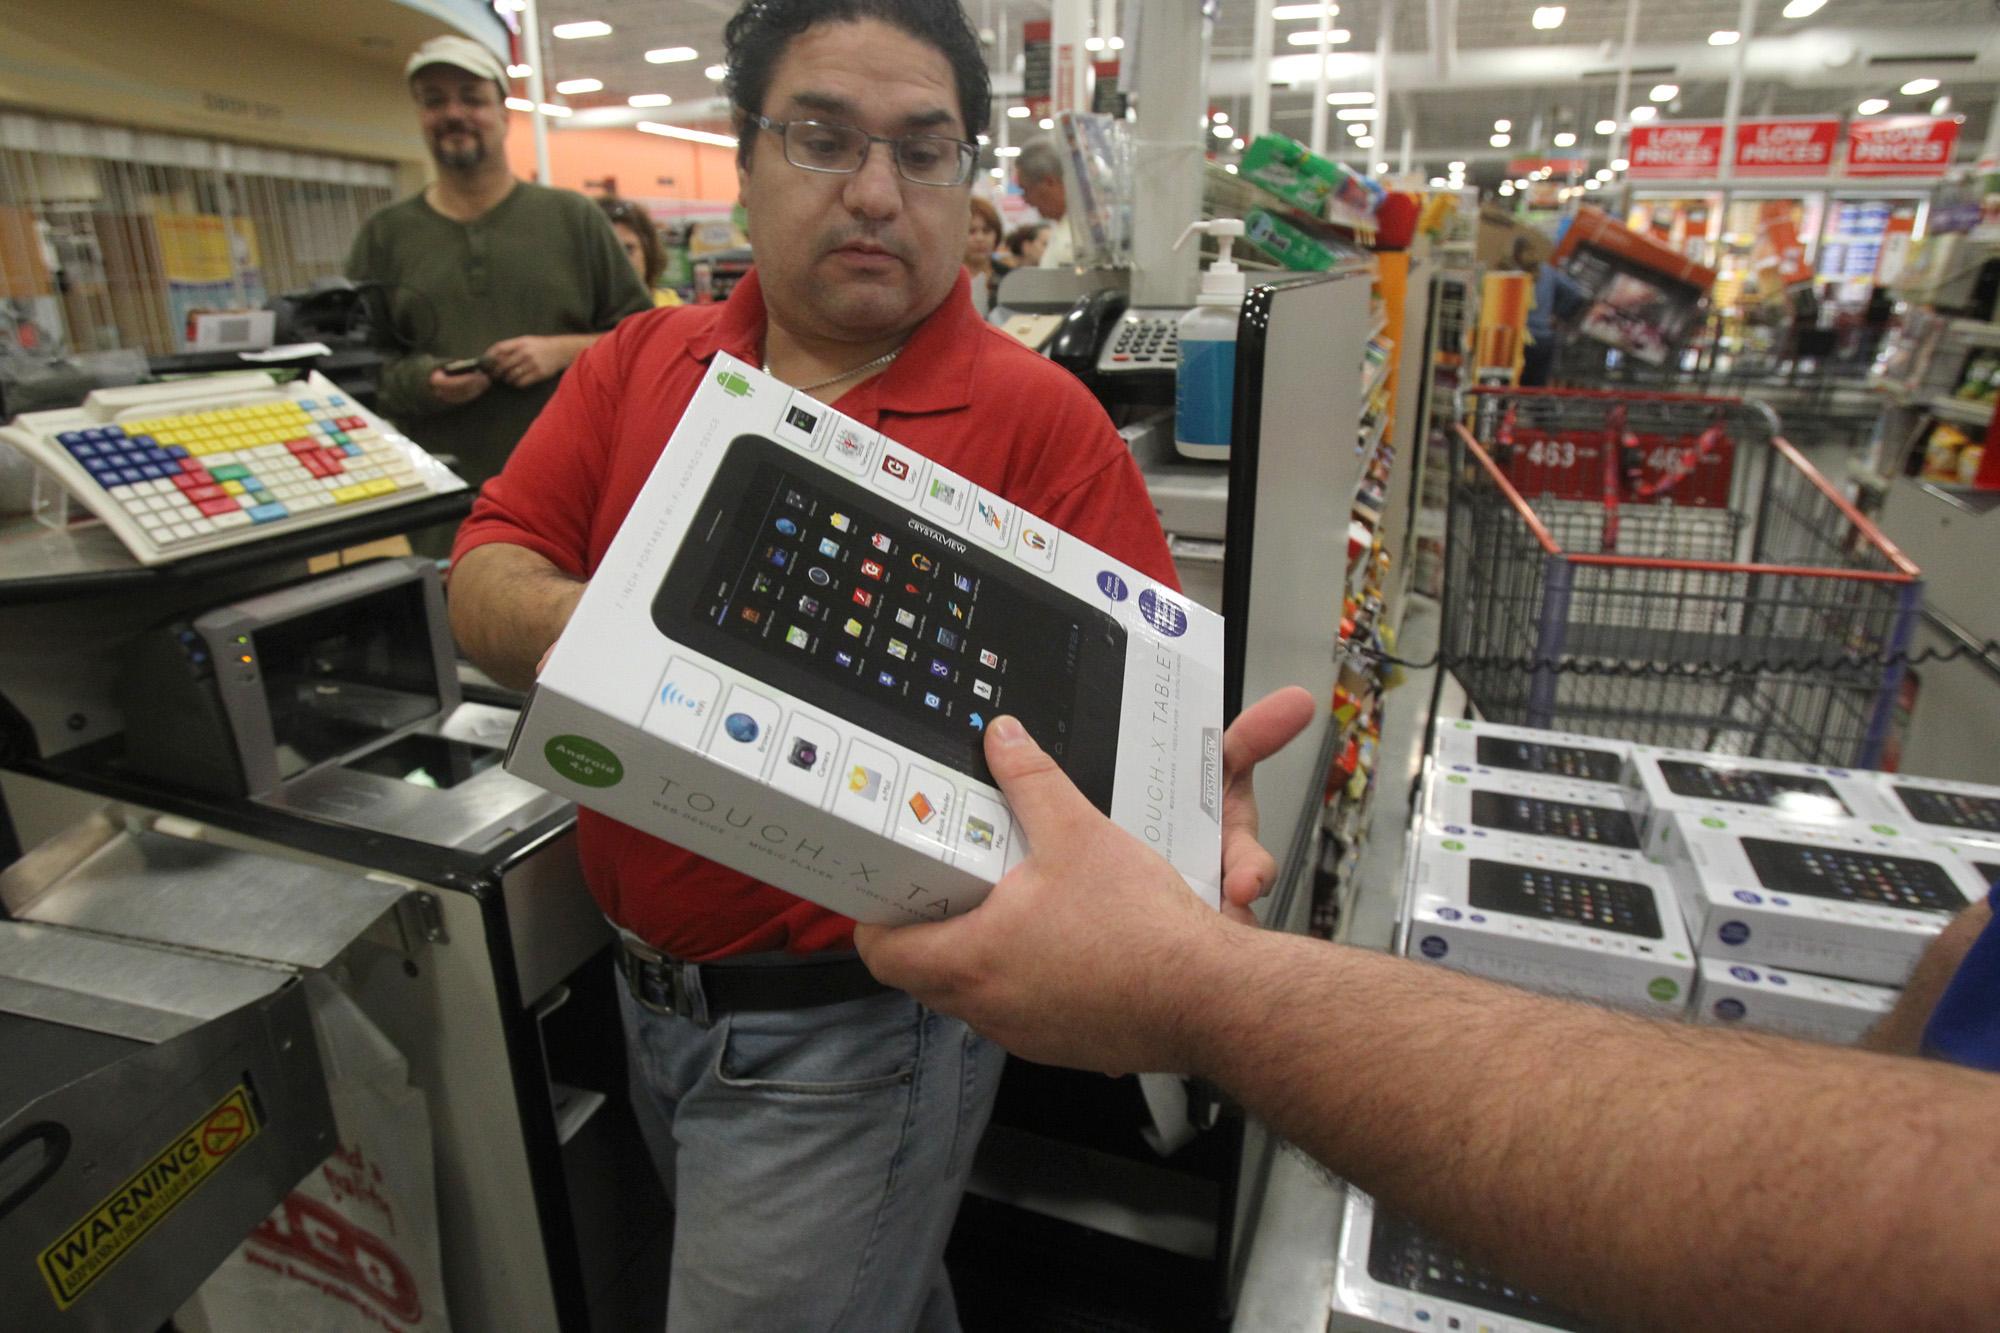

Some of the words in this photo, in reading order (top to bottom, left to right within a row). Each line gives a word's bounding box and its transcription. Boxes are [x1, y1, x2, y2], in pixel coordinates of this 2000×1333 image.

[1649, 127, 1706, 147] LOW
[1757, 125, 1816, 146] LOW
[1634, 145, 1715, 165] PRICES
[1740, 143, 1825, 164] PRICES
[1854, 142, 1943, 163] PRICES
[1527, 440, 1576, 469] 463
[639, 516, 669, 570] PORTABLE
[908, 517, 967, 554] CRYSTALVIEW
[1152, 641, 1172, 724] TABLET
[555, 744, 616, 775] Android
[569, 761, 594, 776] 4.0
[1144, 736, 1168, 842] OUCH-X
[53, 1138, 201, 1271] WARNING
